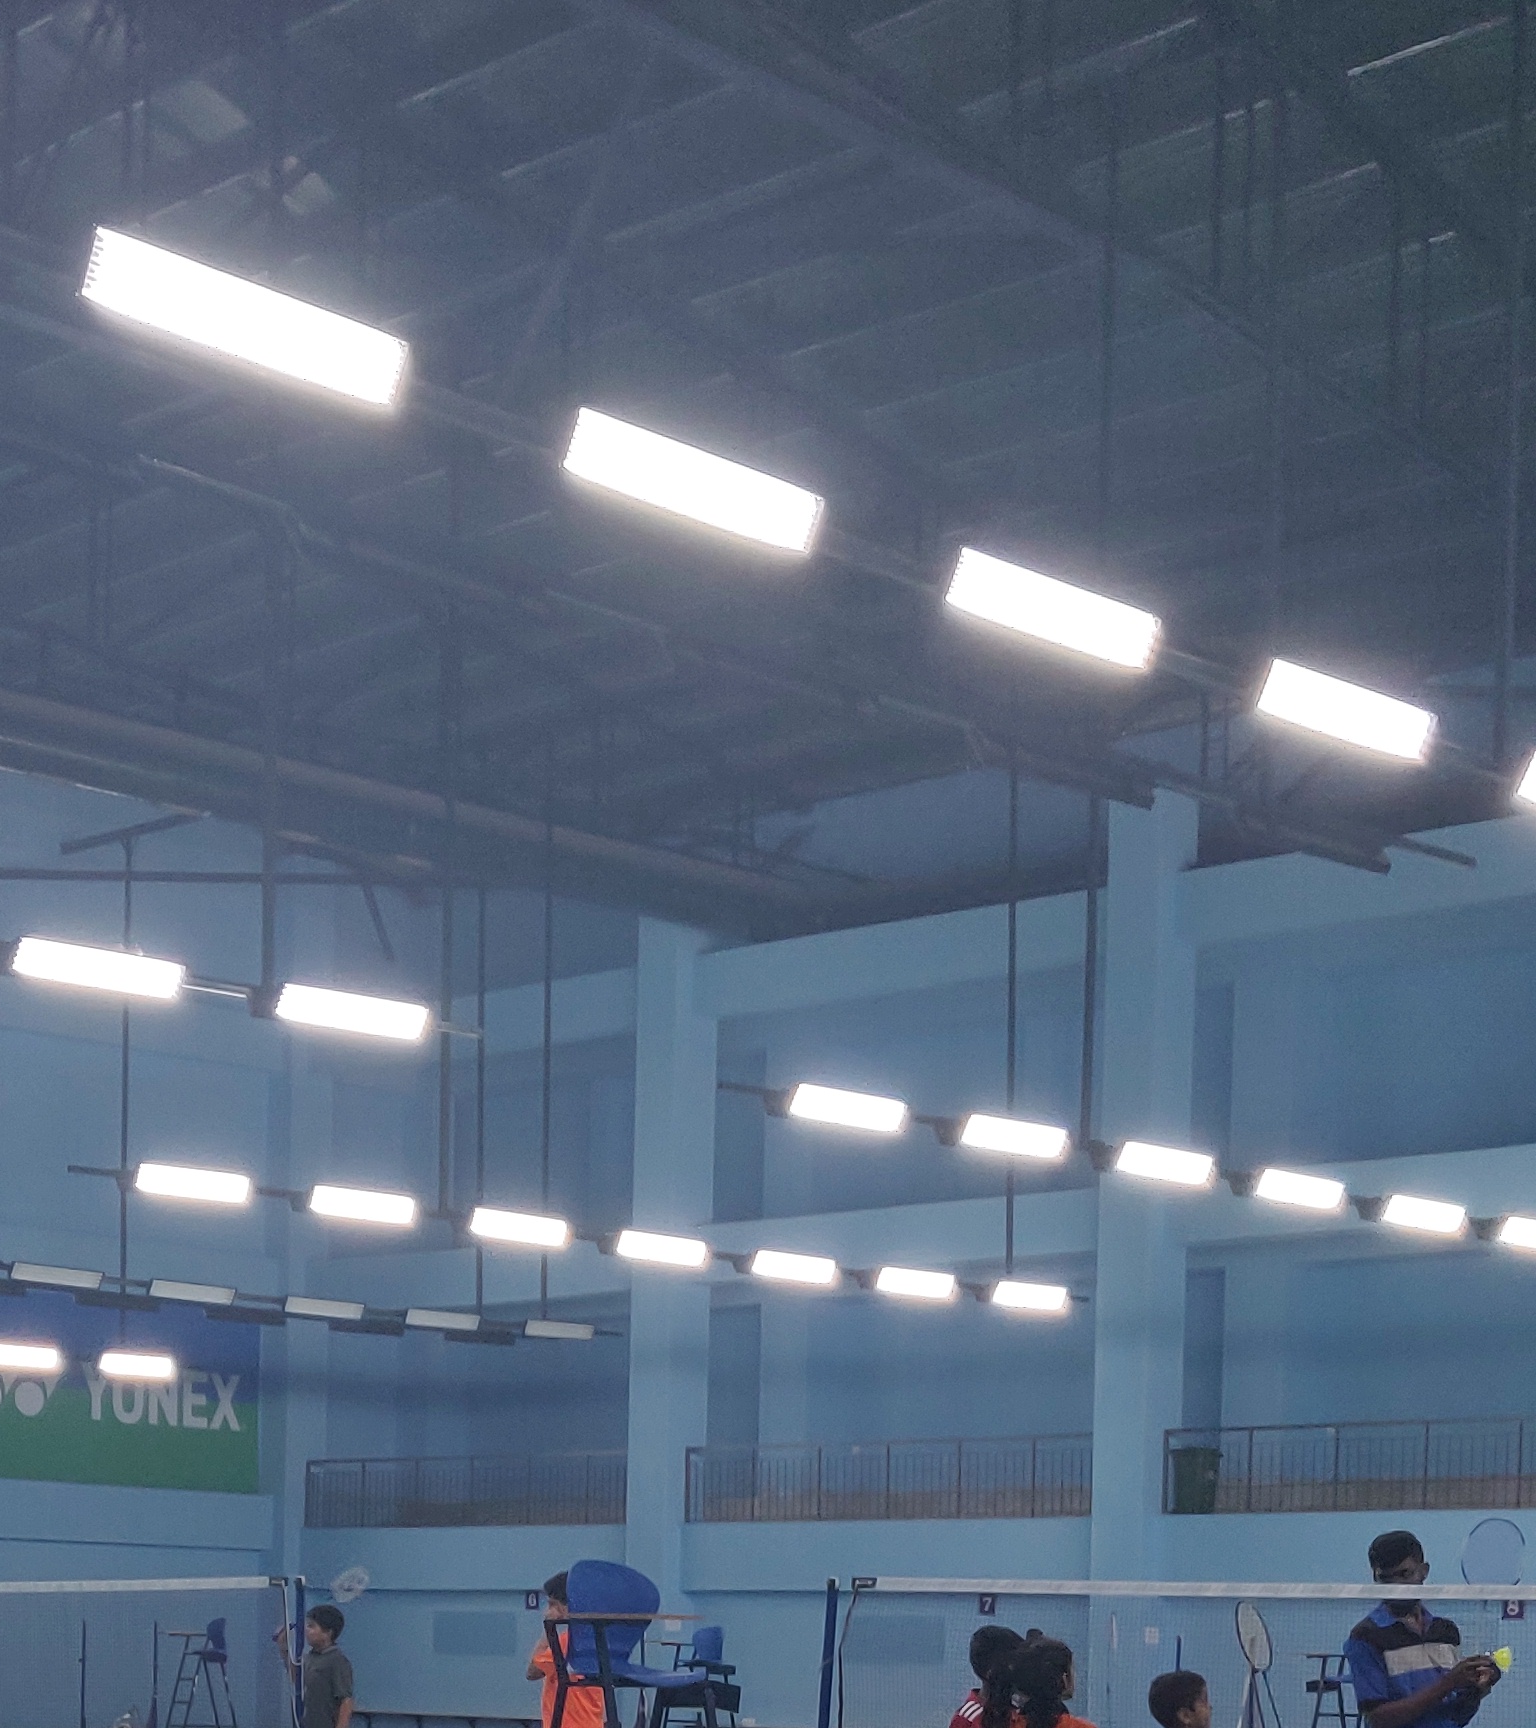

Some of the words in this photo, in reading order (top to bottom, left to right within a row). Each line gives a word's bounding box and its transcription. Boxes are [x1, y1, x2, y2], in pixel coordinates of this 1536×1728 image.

[82, 1361, 240, 1432] YONEX
[982, 1596, 993, 1612] 7
[1506, 1599, 1520, 1616] 8
